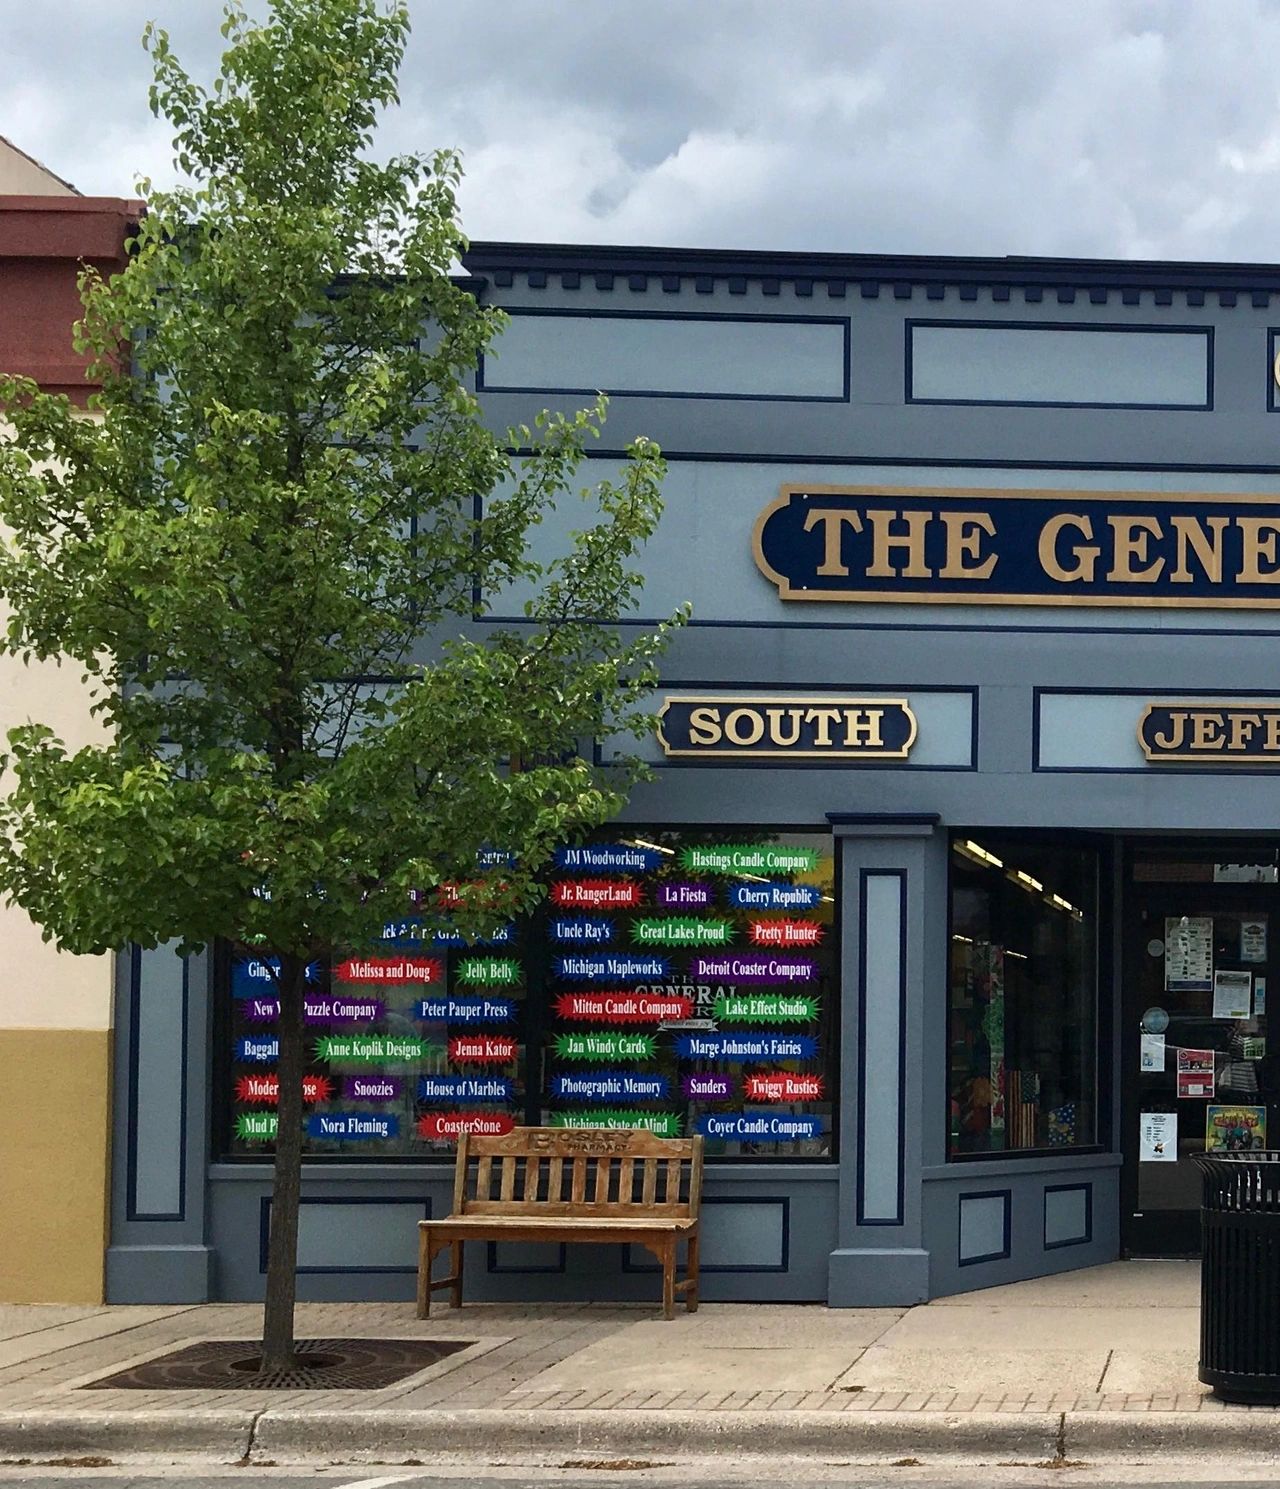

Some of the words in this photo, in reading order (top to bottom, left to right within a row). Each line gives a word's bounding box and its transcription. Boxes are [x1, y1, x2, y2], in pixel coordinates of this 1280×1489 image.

[804, 508, 999, 579] THE
[689, 708, 884, 748] SOUTH
[565, 850, 579, 864] JM
[583, 851, 645, 869] Woodworking
[693, 852, 730, 870] Hastings
[733, 852, 764, 866] Candle
[767, 853, 809, 871] Company
[561, 886, 573, 900] Jr.
[576, 886, 631, 904] RangerLand
[666, 888, 677, 901] La
[681, 888, 706, 902] Fiesta
[739, 888, 769, 906] Cherry
[773, 889, 811, 906] Republic
[558, 923, 582, 937] Uncle
[585, 924, 609, 941] Ray's
[640, 924, 665, 938] Great
[669, 925, 694, 938] Lakes
[698, 925, 724, 939] Proud
[756, 925, 782, 943] Pretty
[786, 926, 817, 939] Hunter
[350, 963, 383, 977] Melissa
[387, 963, 403, 977] and
[406, 964, 430, 982] Doug
[466, 964, 486, 982] Jelly
[491, 964, 511, 982] Belly
[563, 960, 604, 977] Michigan
[608, 960, 662, 978] Mapleworks
[699, 961, 729, 975] Detroit
[733, 961, 767, 975] Coaster
[769, 961, 811, 979] Company
[255, 1001, 272, 1015] New
[333, 1002, 376, 1020] Company
[423, 1002, 446, 1016] Peter
[449, 1002, 481, 1020] Pauper
[485, 1002, 507, 1016] Press
[573, 999, 602, 1013] Mitten
[605, 999, 637, 1014] Candle
[640, 1000, 681, 1018] Company
[726, 1001, 748, 1014] Lake
[751, 1001, 776, 1015] Effect
[779, 1001, 807, 1015] Studio
[327, 1042, 350, 1055] Anne
[353, 1041, 383, 1060] Koplik
[387, 1042, 420, 1059] Designs
[456, 1042, 482, 1056] Jenna
[486, 1042, 512, 1056] Kator
[568, 1039, 584, 1053] Jan
[587, 1039, 616, 1056] Windy
[619, 1039, 645, 1053] Cards
[691, 1040, 719, 1058] Marge
[722, 1040, 768, 1054] Johnston's
[772, 1040, 801, 1054] Fairies
[249, 1081, 279, 1095] Moder
[355, 1081, 393, 1095] Snoozies
[427, 1081, 454, 1095] House
[457, 1081, 466, 1095] of
[469, 1081, 505, 1095] Marbles
[562, 1079, 621, 1096] Photographic
[624, 1079, 660, 1096] Memory
[691, 1079, 726, 1093] Sanders
[752, 1079, 783, 1097] Twiggy
[787, 1080, 818, 1093] Rustics
[246, 1118, 266, 1132] Mud
[321, 1119, 344, 1132] Nora
[348, 1119, 387, 1136] Fleming
[437, 1118, 500, 1134] CoasterStone
[608, 1119, 629, 1129] State
[632, 1119, 641, 1129] of
[643, 1119, 667, 1132] Mind
[708, 1119, 735, 1136] Coyer
[737, 1119, 768, 1133] Candle
[771, 1119, 812, 1137] Company
